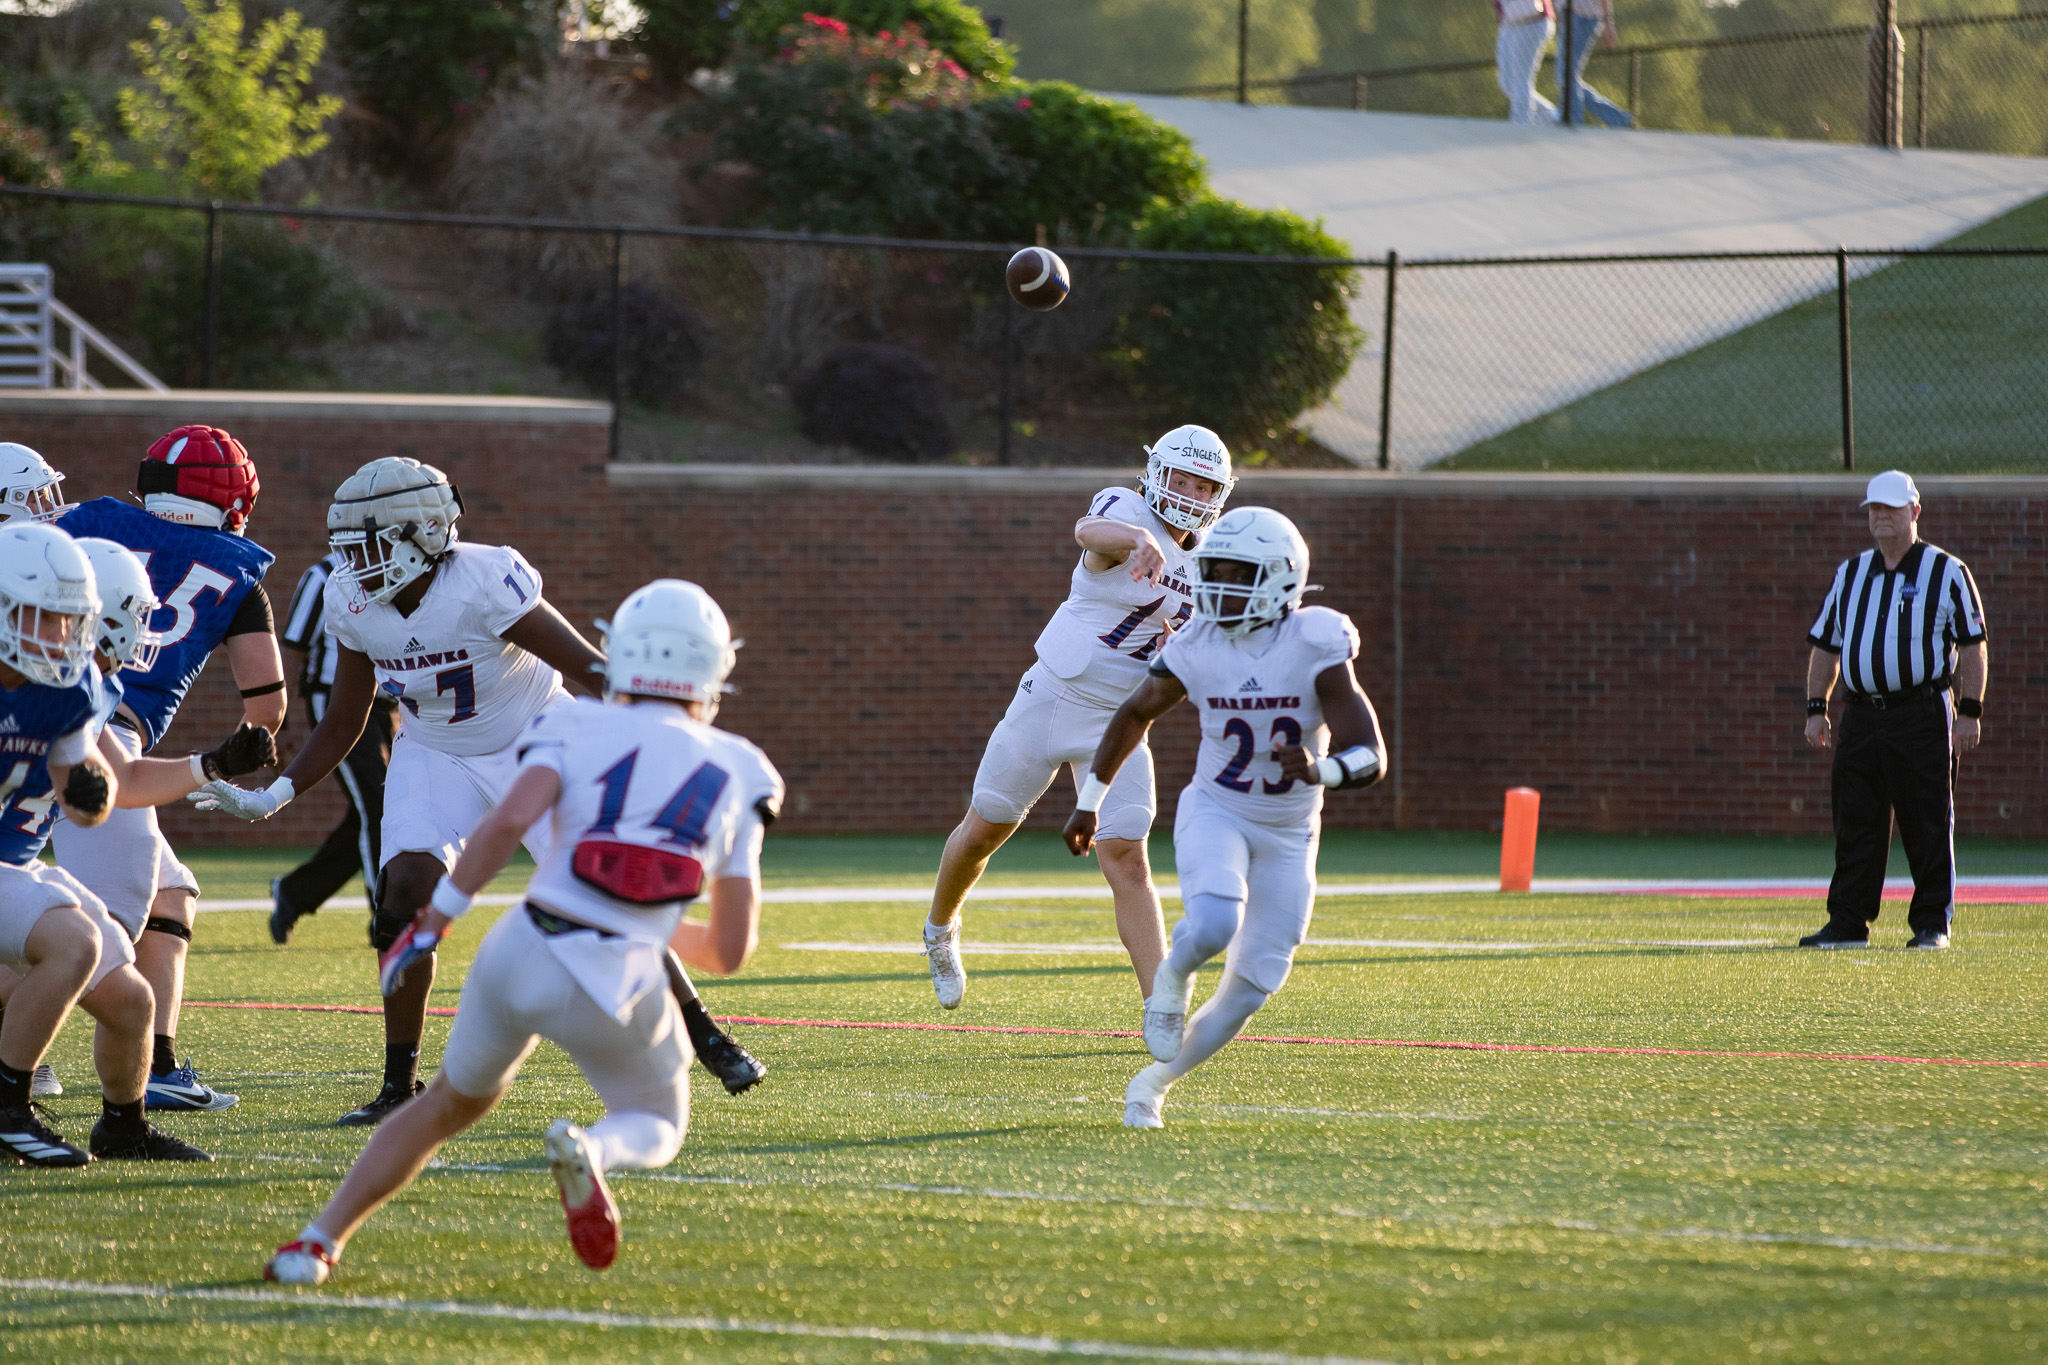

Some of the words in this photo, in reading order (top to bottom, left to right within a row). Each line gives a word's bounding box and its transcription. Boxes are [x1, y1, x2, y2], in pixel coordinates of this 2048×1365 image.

[373, 648, 469, 672] WARHAWKS
[403, 645, 425, 654] adidas
[1206, 696, 1301, 711] WARHAWKS
[0, 737, 49, 757] AWKS
[1213, 716, 1302, 796] 23
[582, 748, 731, 848] 14
